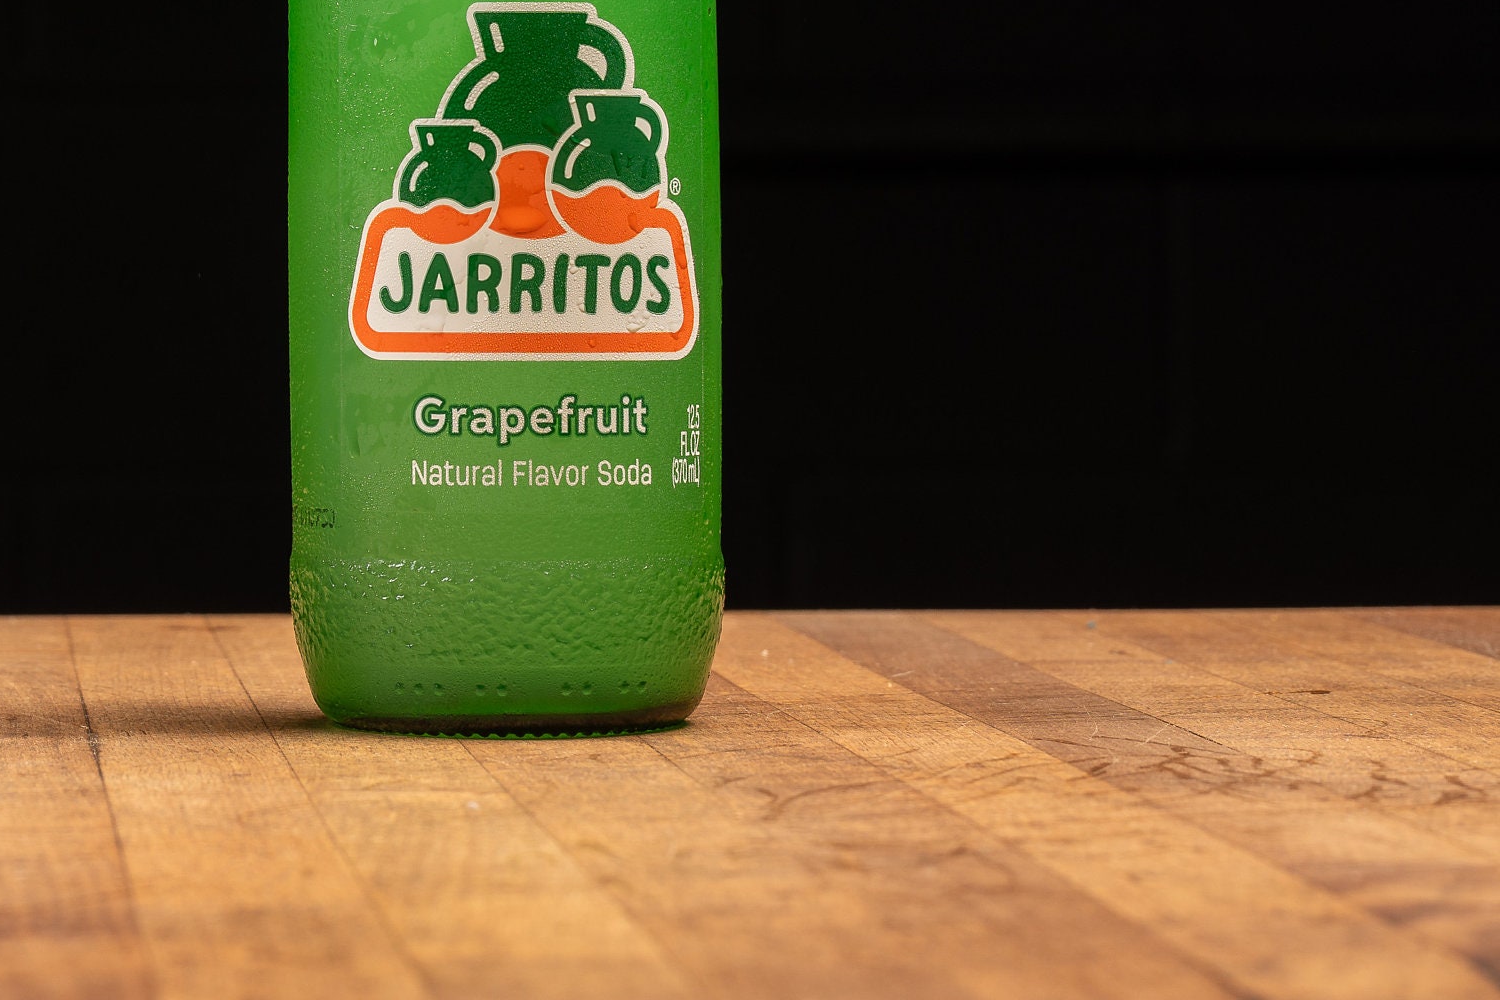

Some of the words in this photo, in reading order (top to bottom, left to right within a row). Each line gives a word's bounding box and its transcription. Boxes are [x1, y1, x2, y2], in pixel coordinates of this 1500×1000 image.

[379, 251, 671, 315] JARRITOS
[412, 394, 649, 446] Grapefruit
[690, 430, 700, 456] OZ
[411, 460, 503, 486] Natural
[513, 460, 590, 486] Flavor
[597, 460, 653, 487] Soda
